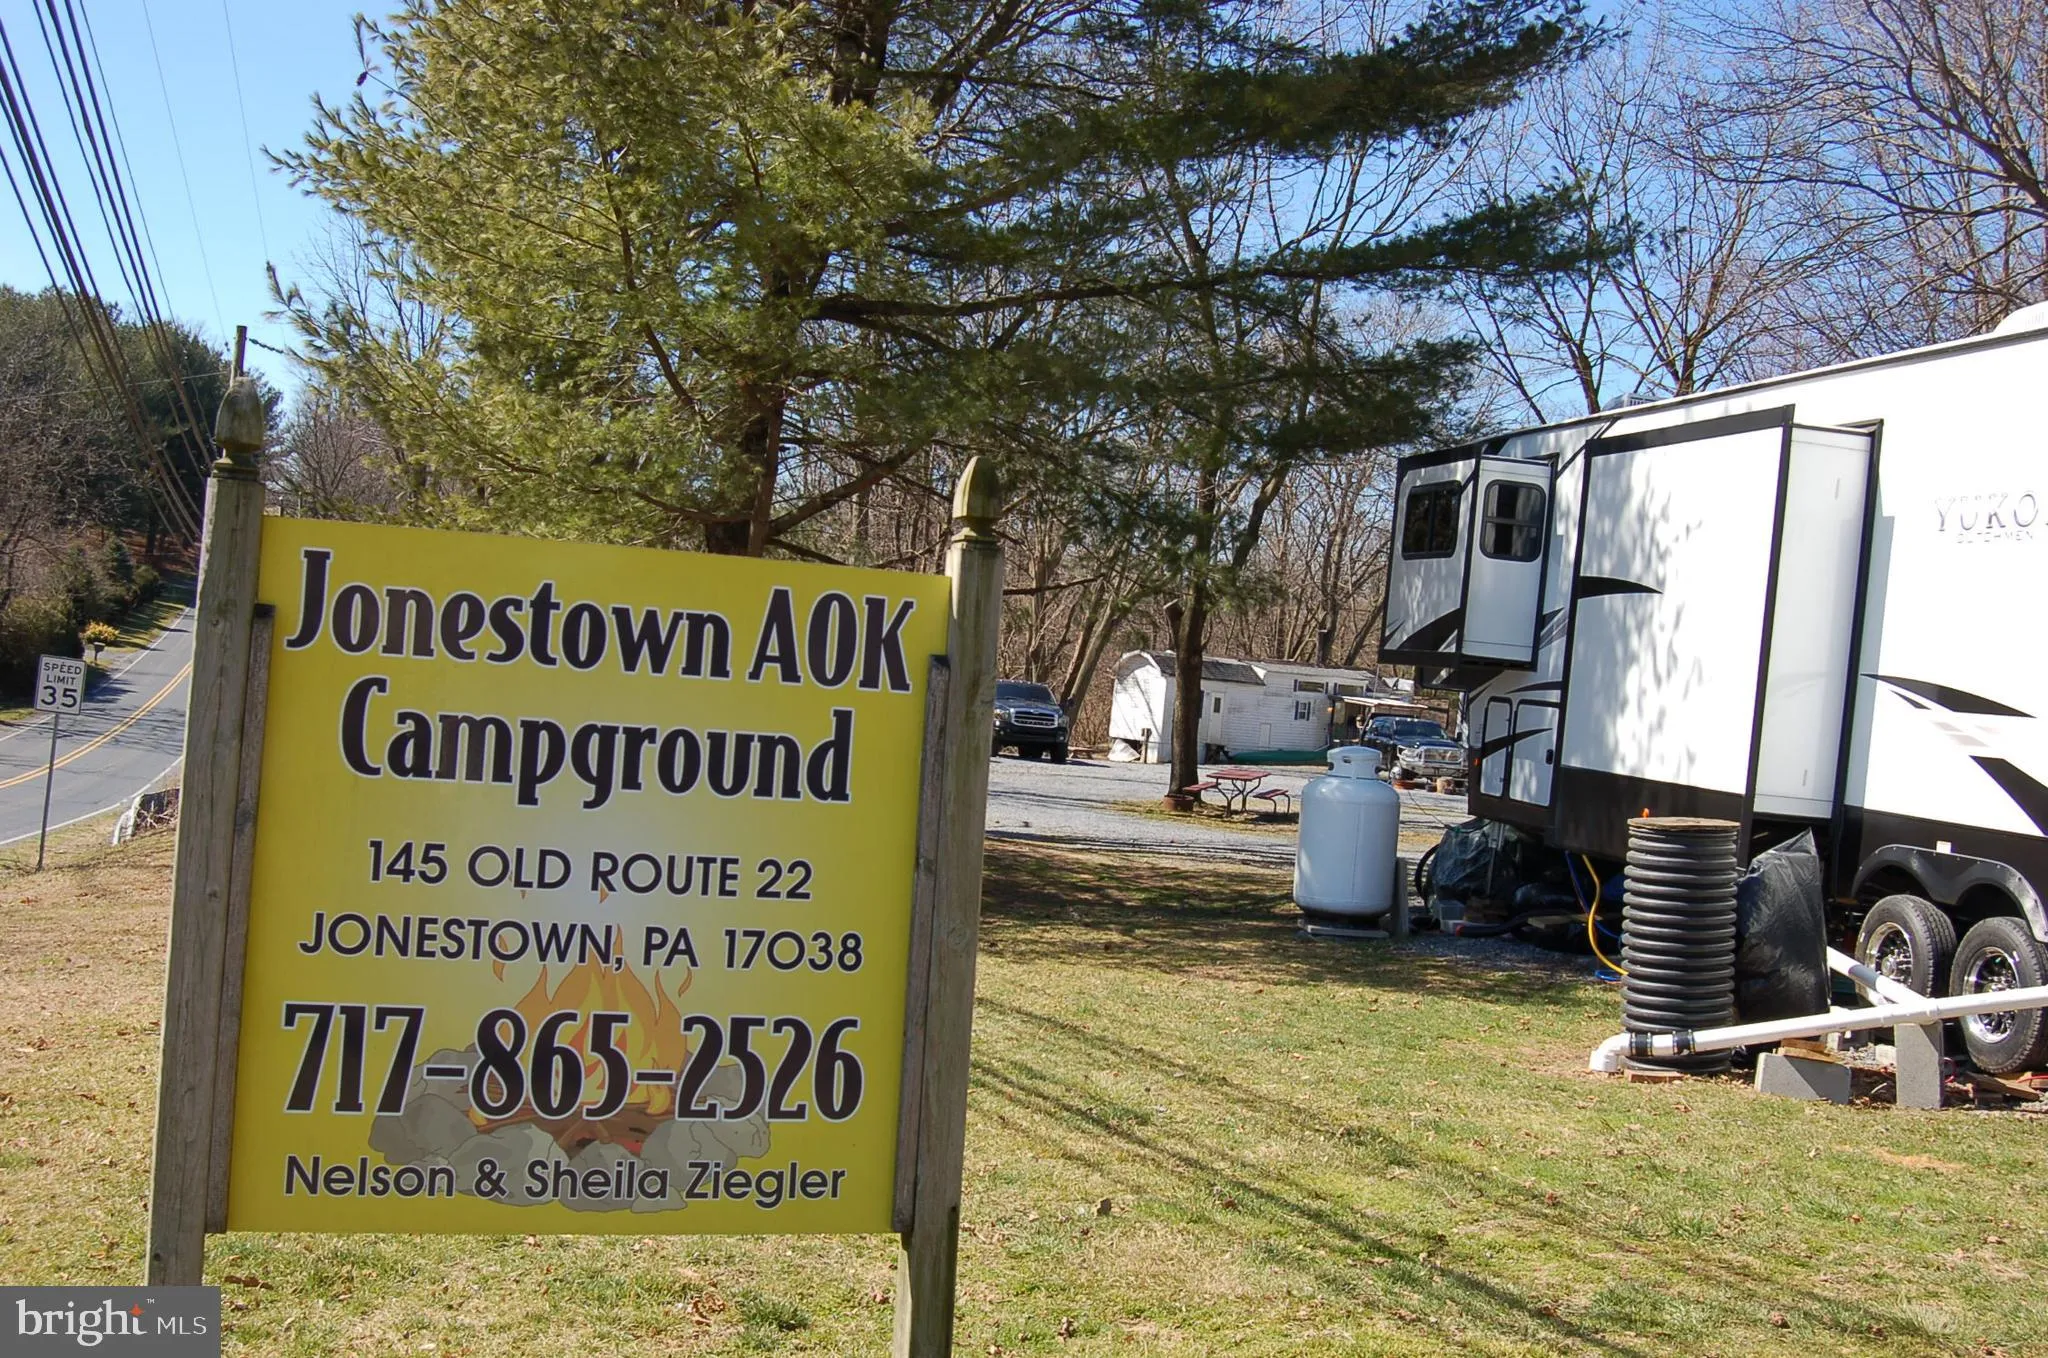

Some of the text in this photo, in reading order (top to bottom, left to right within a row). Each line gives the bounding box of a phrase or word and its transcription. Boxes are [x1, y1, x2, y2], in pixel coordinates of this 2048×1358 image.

[1935, 491, 2048, 531] YUKO
[284, 546, 916, 694] Jonestown AOK
[40, 685, 78, 708] 35
[43, 662, 82, 675] SPEED
[46, 674, 76, 685] LIMIT
[340, 674, 854, 809] Campground
[367, 839, 814, 901] 145 OLD ROUTE 22
[298, 911, 864, 973] JONESTOWN, PA 17038
[282, 1001, 865, 1124] 717-865-2526
[283, 1154, 848, 1212] Nelson & Sheila Ziegler
